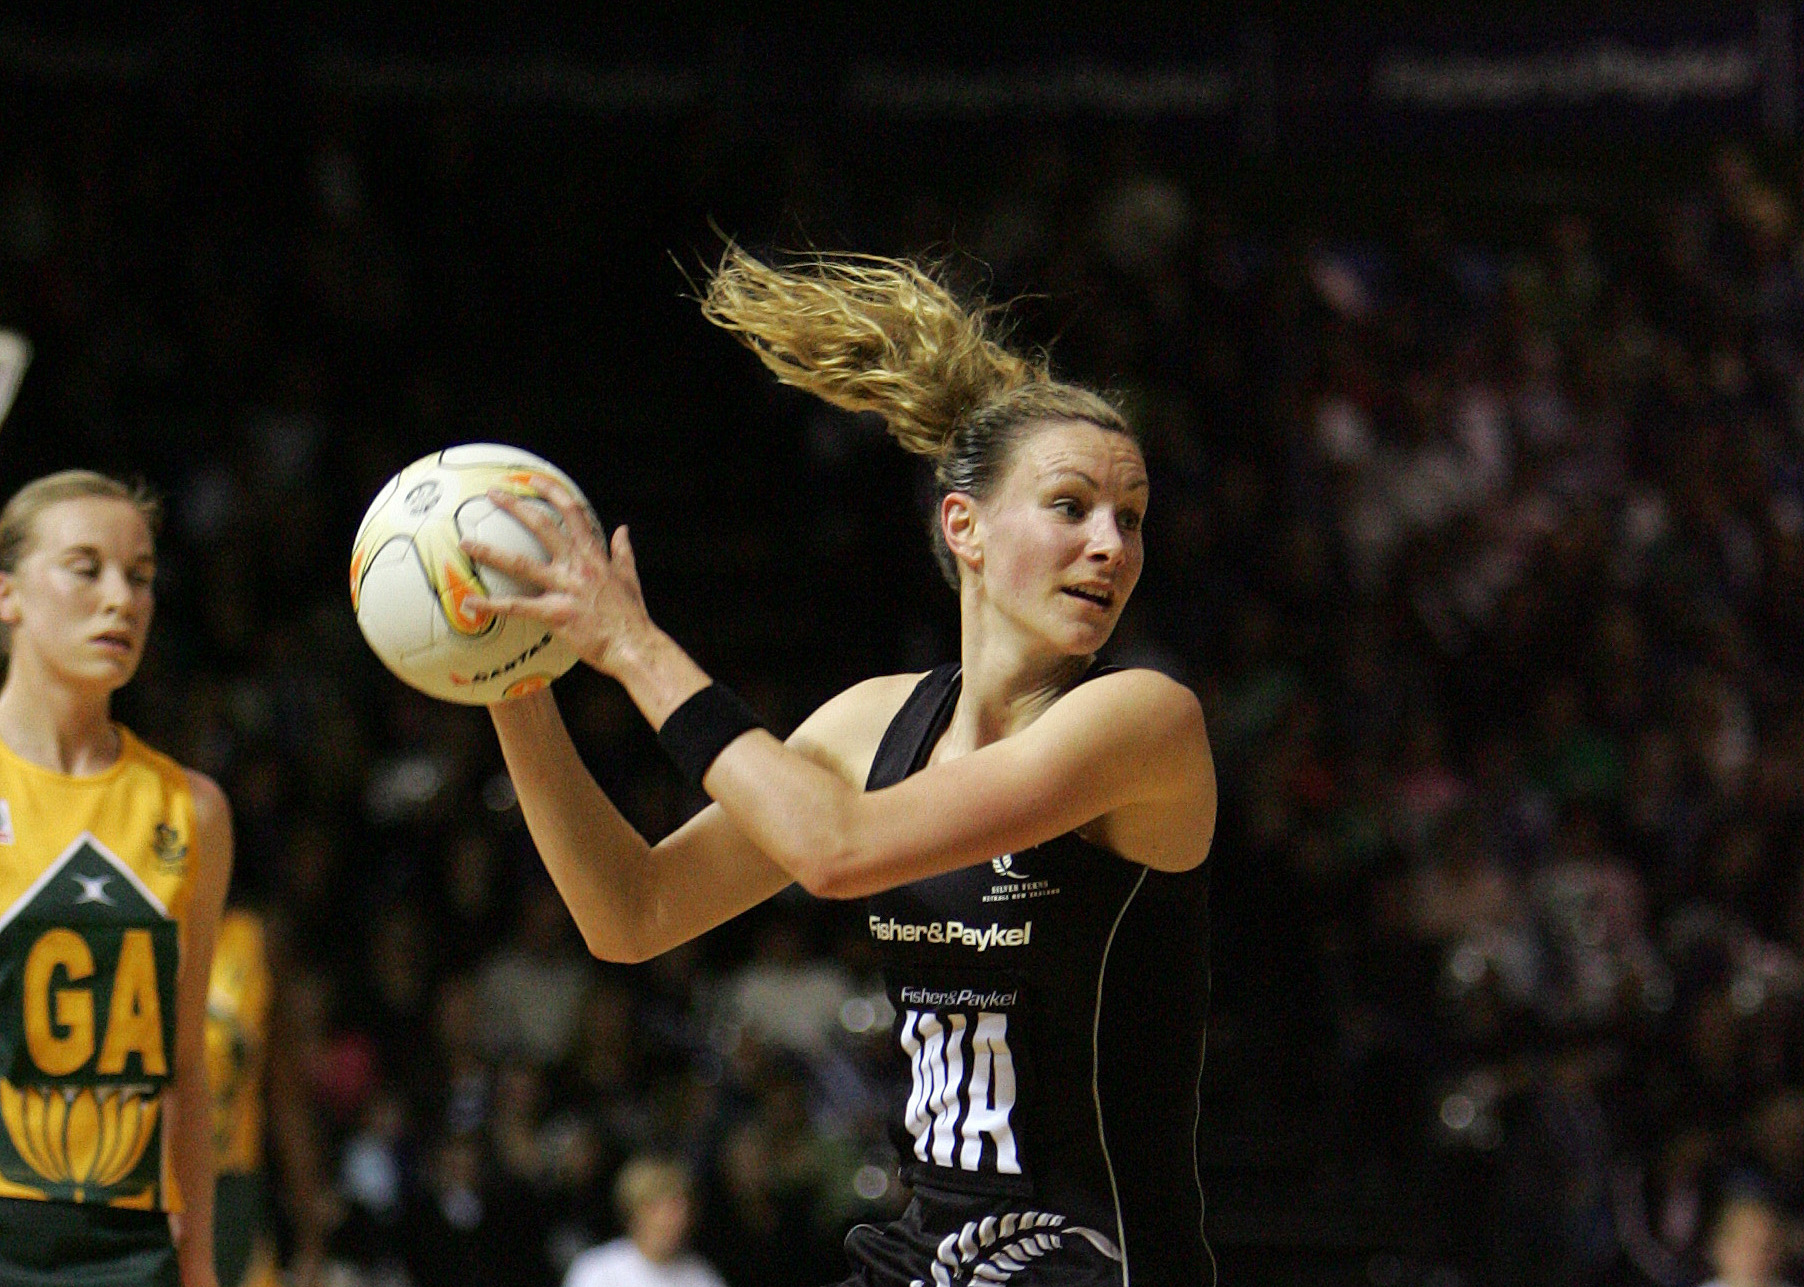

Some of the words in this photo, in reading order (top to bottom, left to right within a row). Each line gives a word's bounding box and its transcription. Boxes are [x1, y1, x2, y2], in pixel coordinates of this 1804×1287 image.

[868, 914, 1033, 952] Fisher&Paykel
[23, 926, 168, 1077] GA
[901, 985, 1018, 1010] Fisher&Paykel
[900, 1010, 1022, 1175] WA
